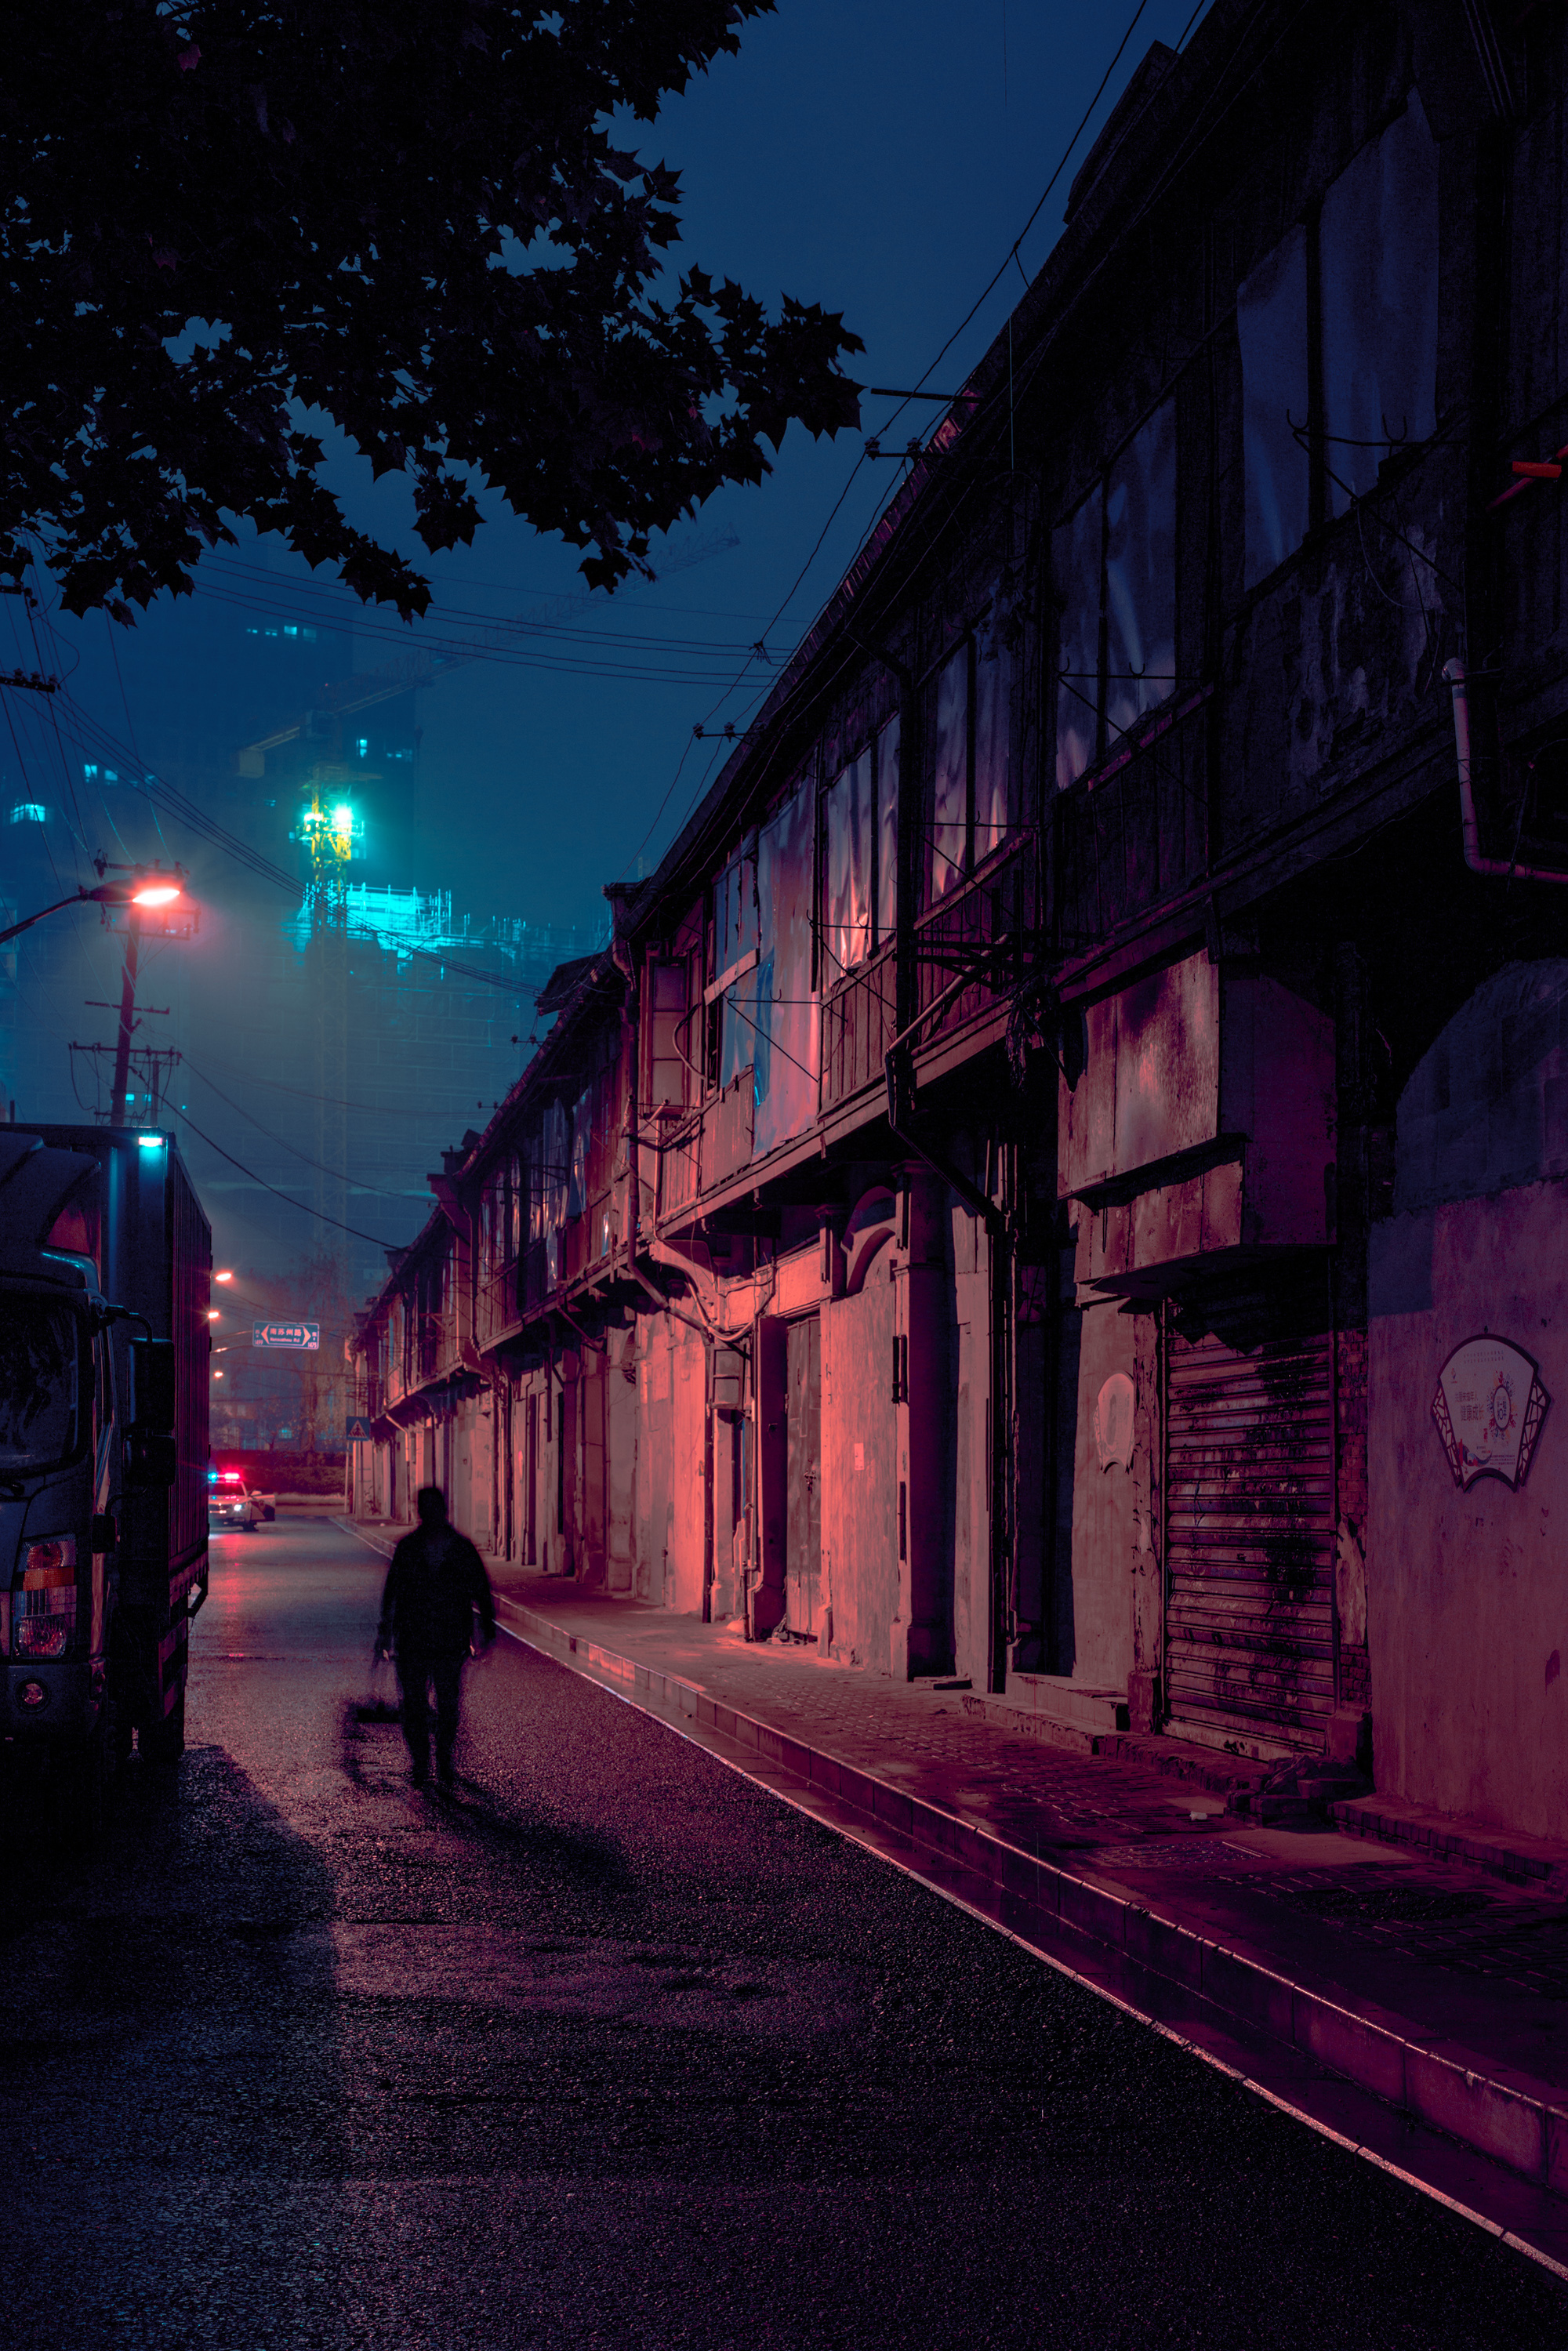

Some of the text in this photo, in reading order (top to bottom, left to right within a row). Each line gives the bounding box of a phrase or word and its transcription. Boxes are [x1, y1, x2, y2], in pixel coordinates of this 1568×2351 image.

[270, 1328, 301, 1337] 南苏州路
[1461, 1403, 1485, 1421] 健康成长
